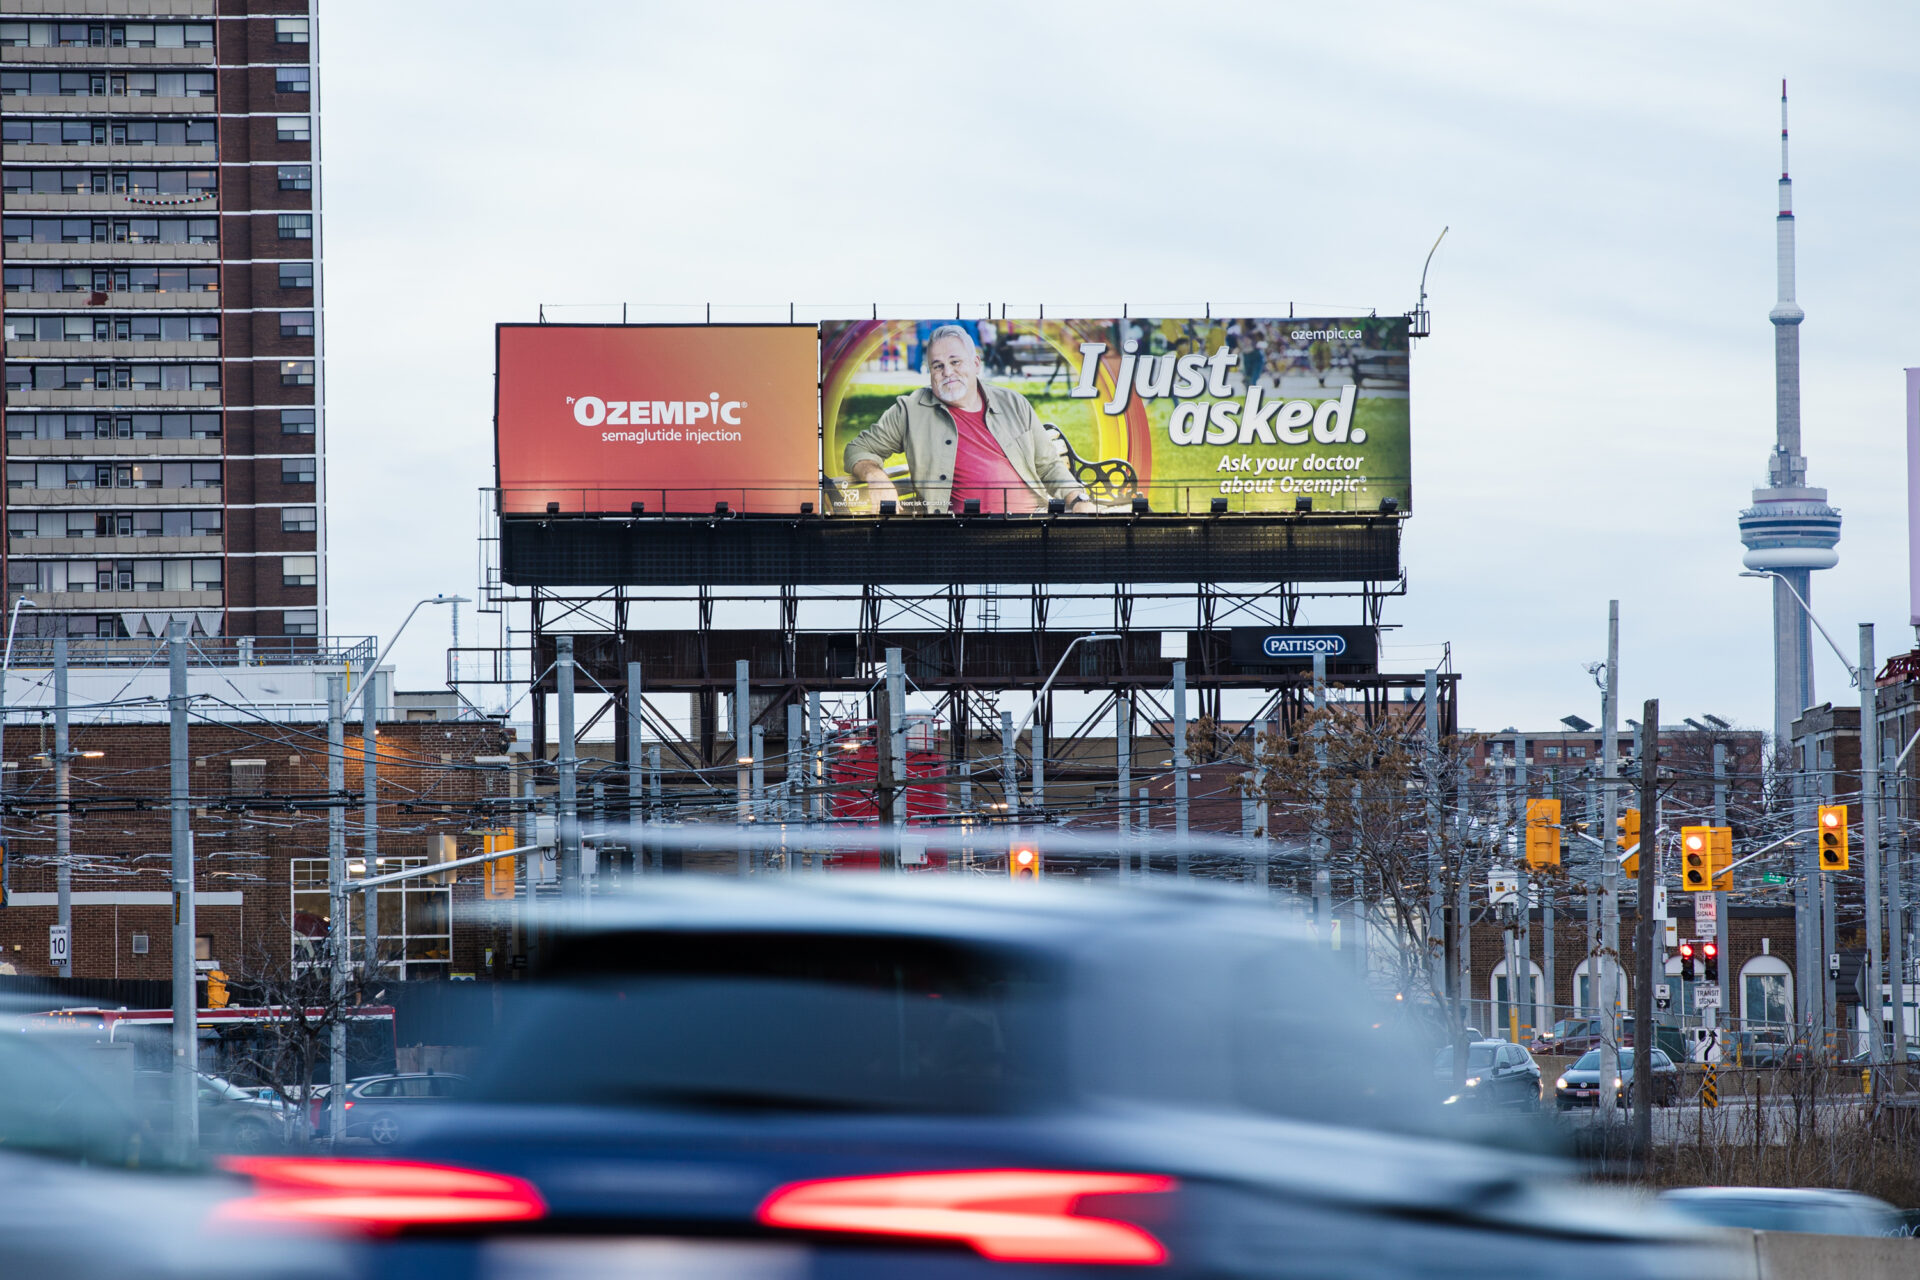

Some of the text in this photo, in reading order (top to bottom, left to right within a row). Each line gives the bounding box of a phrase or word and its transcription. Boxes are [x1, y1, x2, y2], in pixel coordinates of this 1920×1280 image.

[1290, 327, 1362, 342] ozempic.ca
[1071, 339, 1239, 416] I just
[1168, 385, 1368, 446] asked.
[601, 428, 742, 445] semaglutide injection
[1217, 453, 1365, 476] Ask your doctor
[1219, 475, 1276, 494] about
[1270, 640, 1339, 652] PATTISON
[51, 937, 66, 954] 10
[1696, 989, 1720, 997] TRANSIT
[1698, 997, 1718, 1005] SIGNAL
